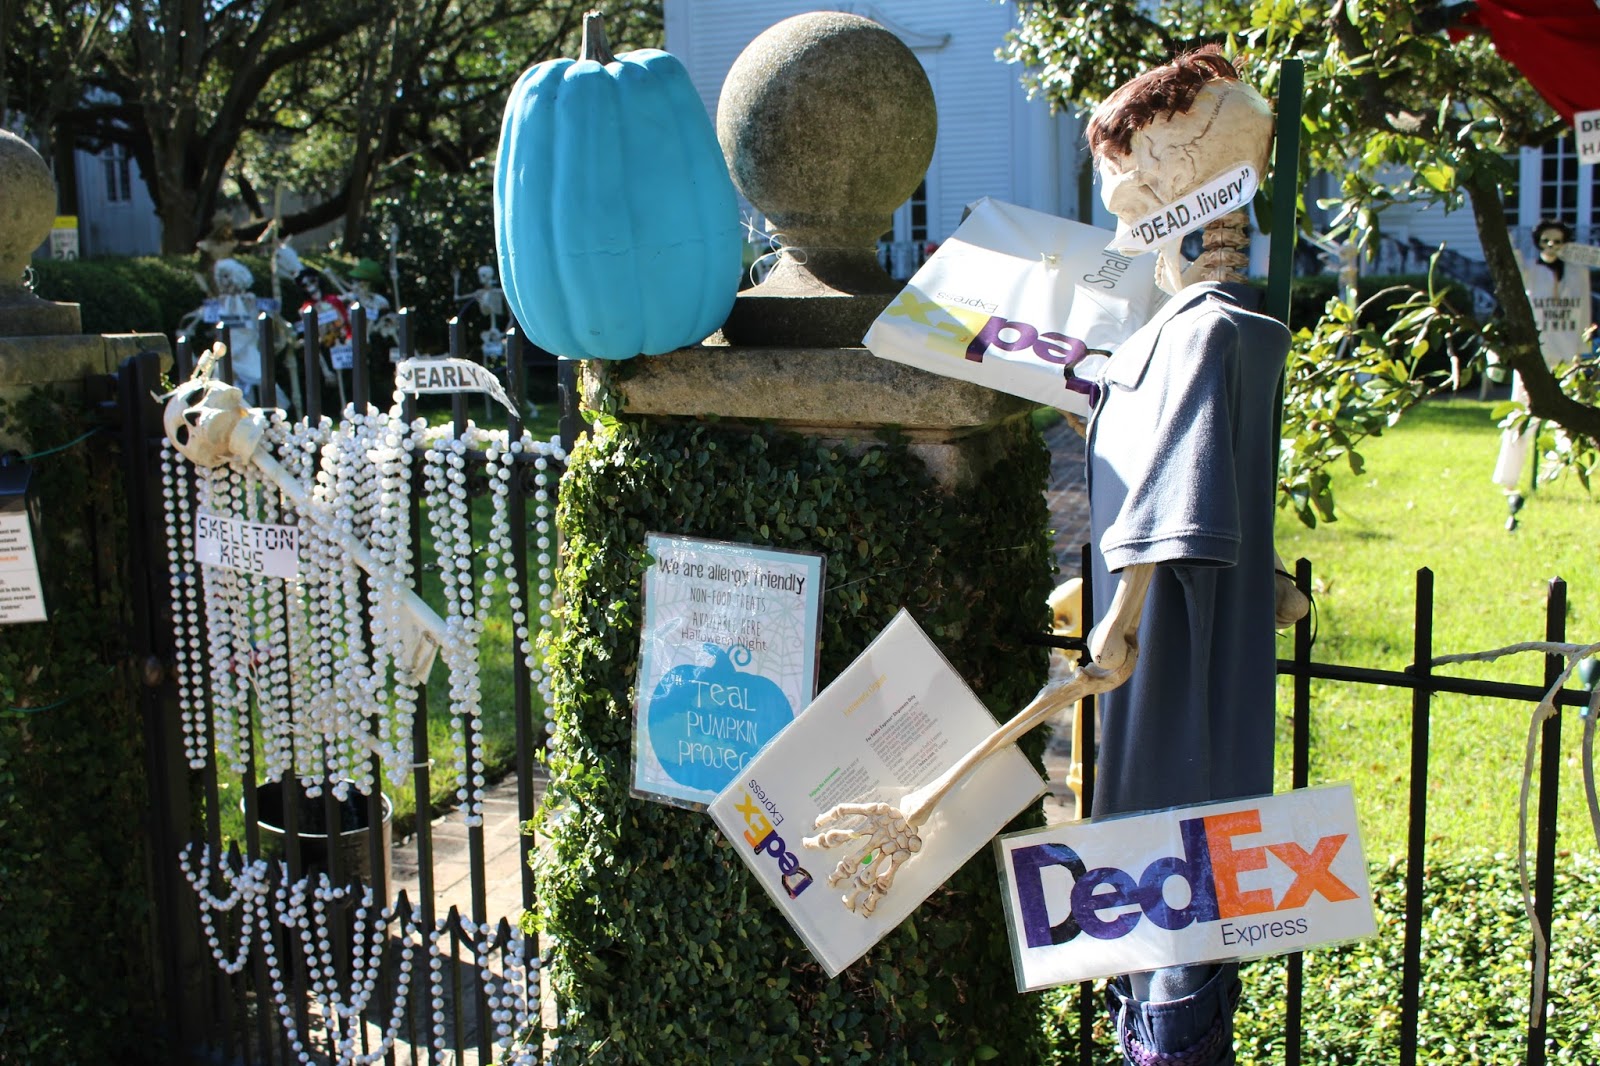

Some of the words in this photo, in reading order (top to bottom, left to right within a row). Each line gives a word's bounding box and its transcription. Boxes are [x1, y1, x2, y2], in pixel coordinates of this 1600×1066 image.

[1582, 142, 1600, 155] H
[1083, 250, 1134, 290] Small
[935, 290, 999, 314] Express
[199, 517, 293, 550] SKELETON
[221, 544, 264, 573] KEYS
[659, 557, 679, 574] We
[683, 562, 704, 578] are
[708, 564, 749, 586] allergy
[754, 568, 806, 595] friendly
[690, 588, 732, 606] NON-FOOD
[735, 594, 766, 612] TREATS
[681, 628, 734, 645] Halloween
[737, 636, 767, 652] Night
[741, 620, 761, 637] HERE
[687, 710, 758, 745] PUMPKIN
[748, 778, 784, 826] Express
[1011, 809, 1360, 949] DedEx
[1221, 917, 1308, 947] Express
